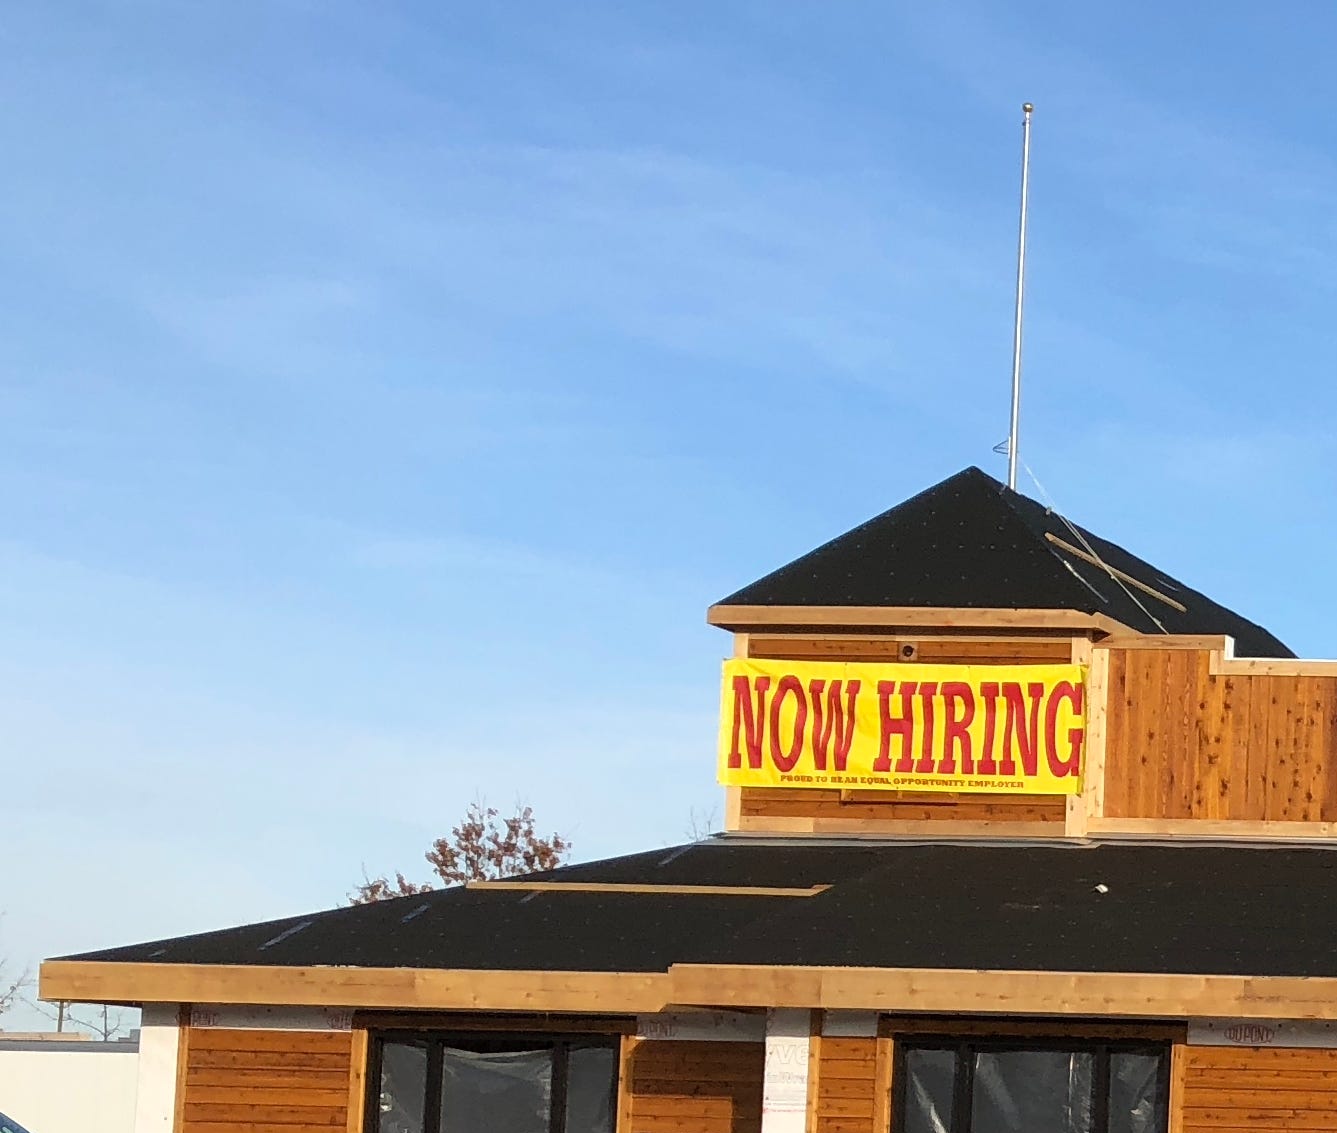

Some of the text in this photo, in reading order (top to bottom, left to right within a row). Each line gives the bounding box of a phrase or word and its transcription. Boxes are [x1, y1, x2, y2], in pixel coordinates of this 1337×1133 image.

[728, 675, 1084, 778] NOW HIRING
[780, 775, 813, 783] PROUD
[861, 777, 891, 785] EQUAL
[894, 778, 966, 788] OPPORTUNITY
[968, 780, 1025, 789] EMPLOYER
